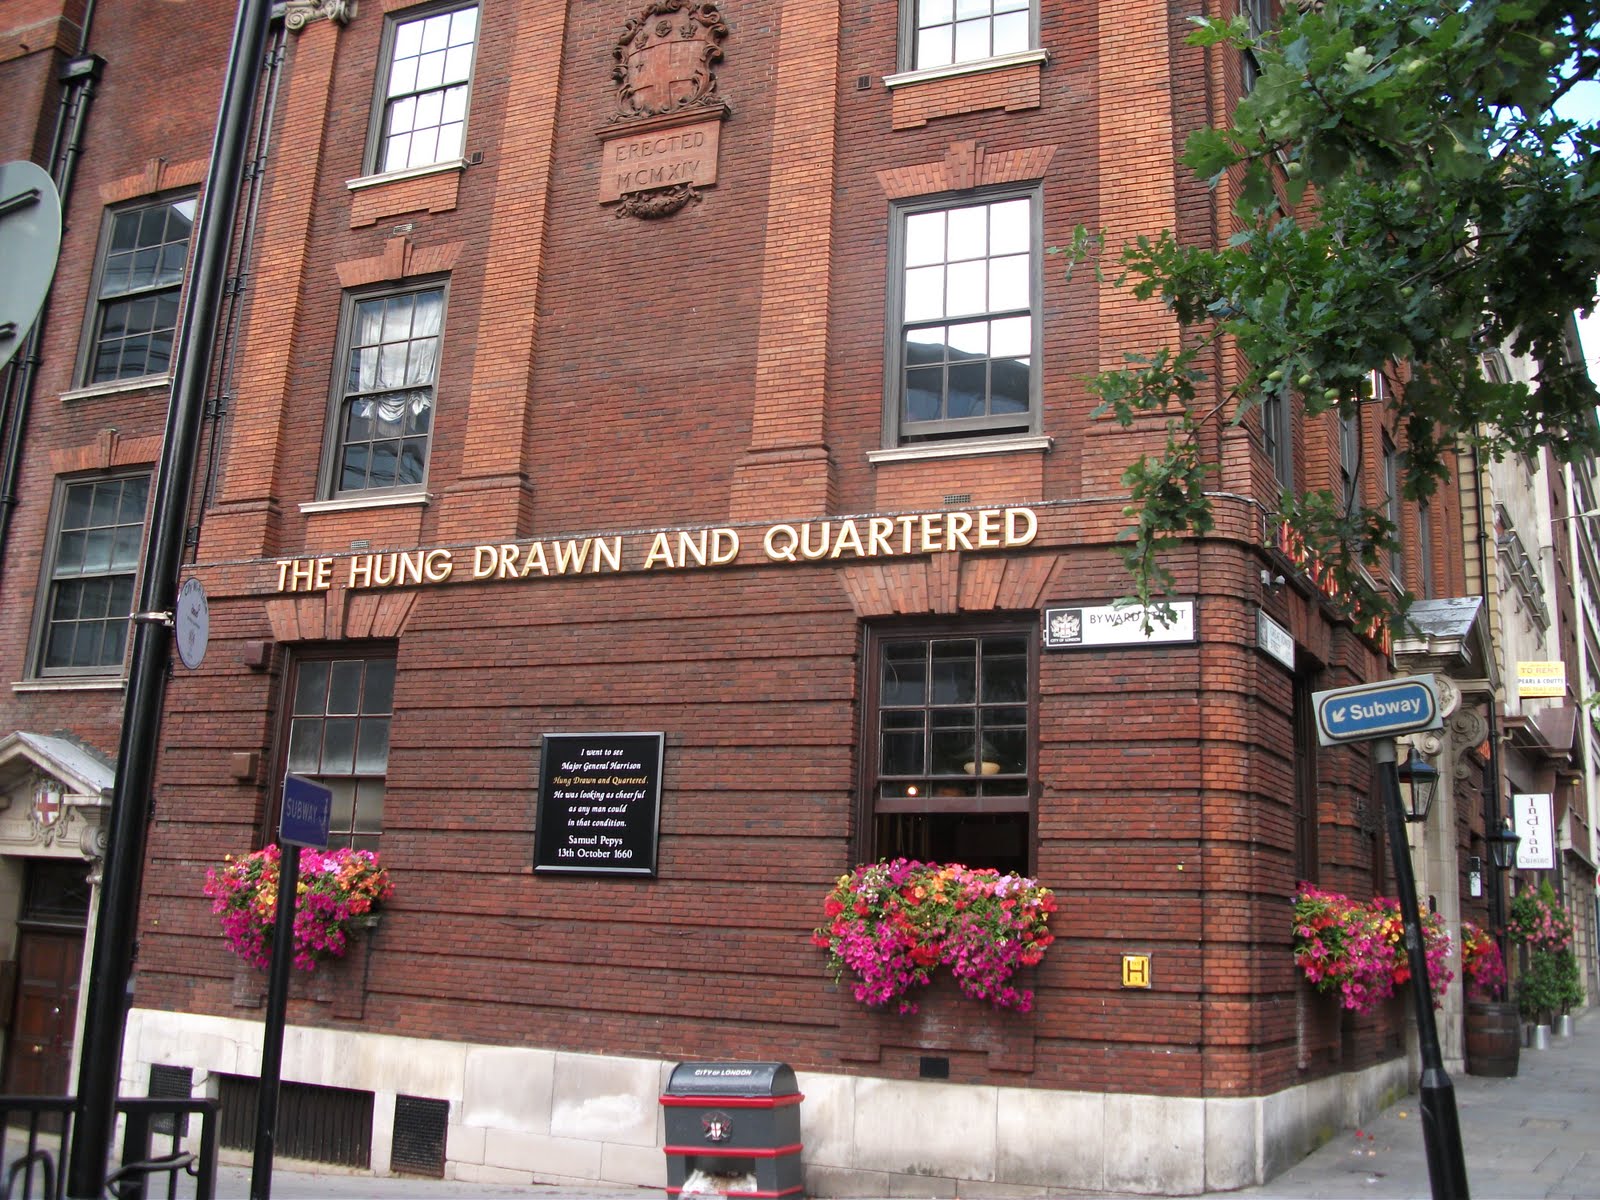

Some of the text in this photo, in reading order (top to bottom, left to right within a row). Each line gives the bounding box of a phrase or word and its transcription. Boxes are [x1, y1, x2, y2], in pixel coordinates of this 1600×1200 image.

[616, 132, 704, 162] ERECTED
[617, 160, 700, 189] MCMXIV
[275, 507, 1038, 592] THE HUNG DRAWN AND QUARTERED
[1350, 698, 1420, 720] Subway
[562, 763, 582, 772] Major
[583, 762, 609, 771] General
[553, 777, 571, 786] Hung
[598, 776, 610, 784] and
[612, 777, 648, 785] Quartered.
[580, 790, 604, 801] looking
[615, 790, 645, 801] cheerful
[287, 798, 317, 823] SUBWAY
[578, 807, 590, 815] any
[608, 804, 627, 813] could
[592, 819, 627, 827] condition.
[1527, 797, 1538, 853] Indian
[569, 835, 623, 846] Samuel Pepys
[558, 849, 632, 858] 13th October 1660
[1127, 960, 1144, 982] H
